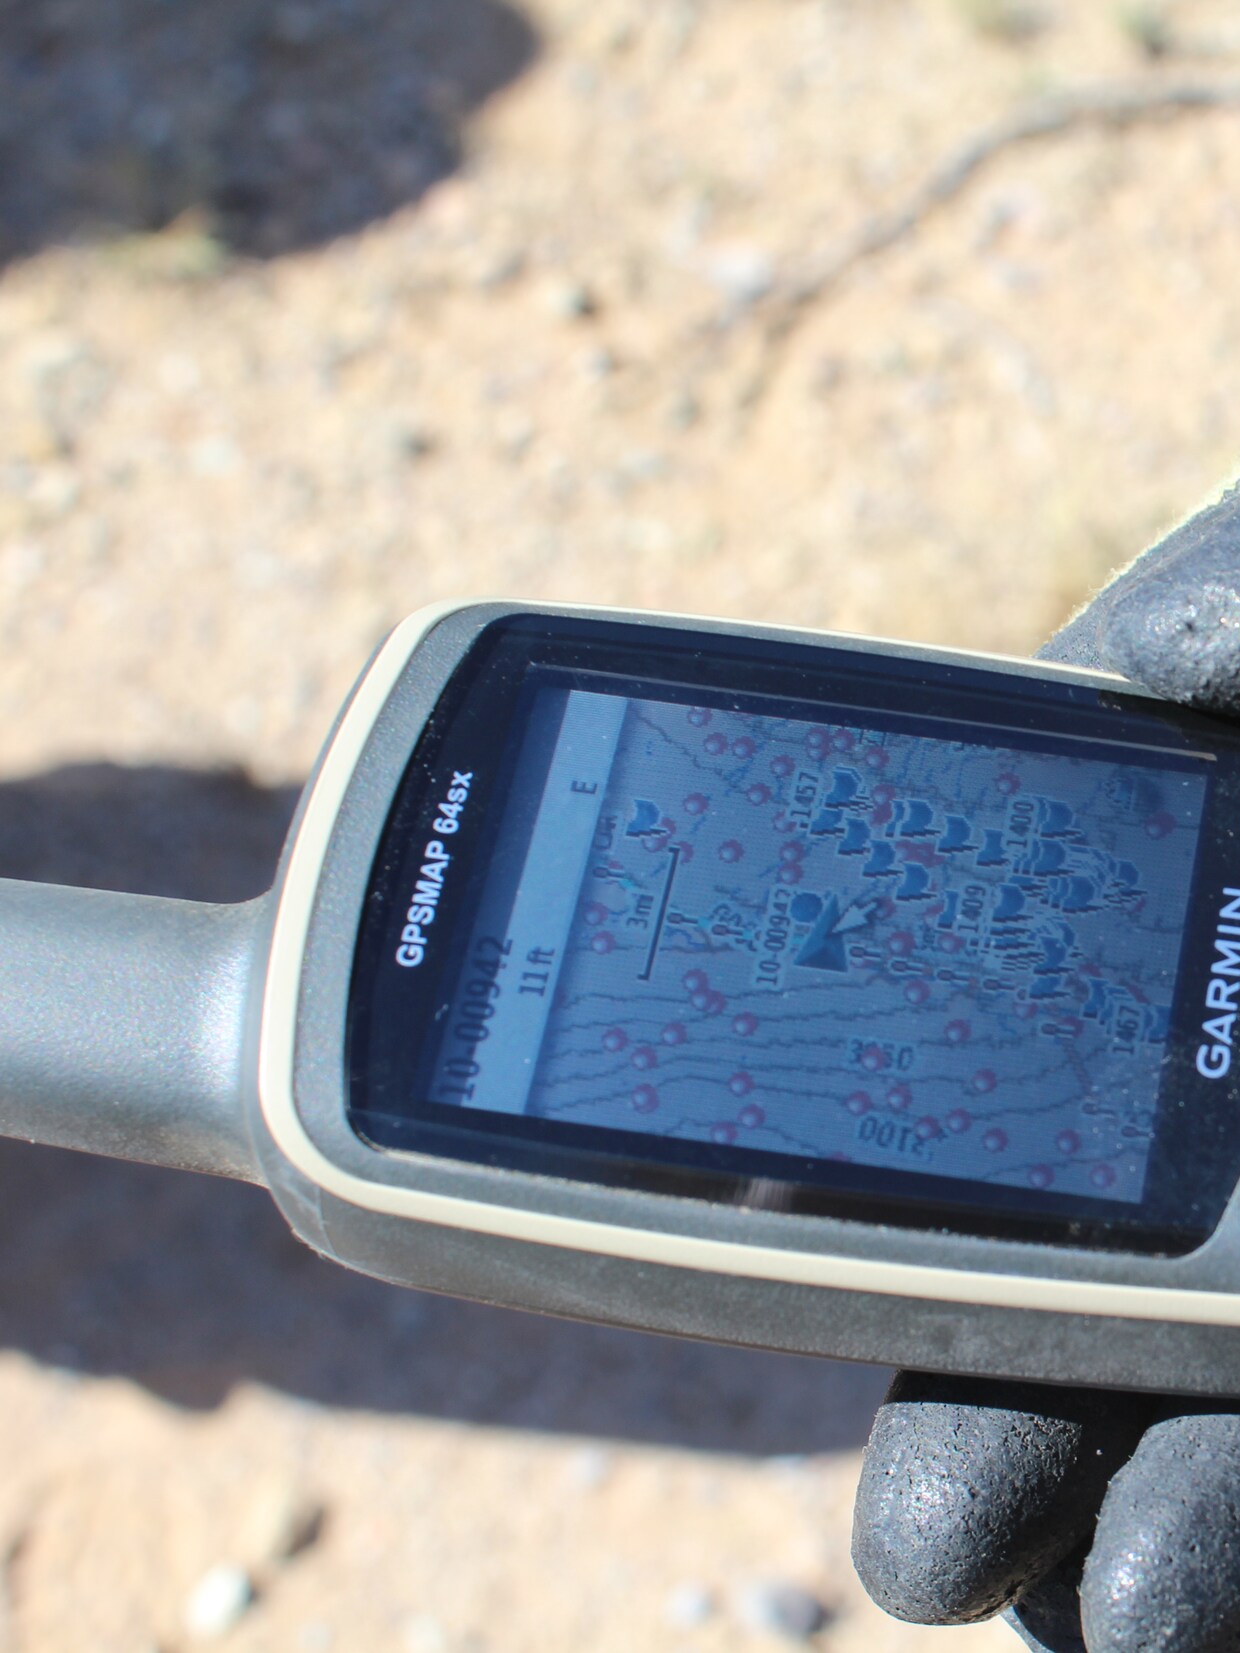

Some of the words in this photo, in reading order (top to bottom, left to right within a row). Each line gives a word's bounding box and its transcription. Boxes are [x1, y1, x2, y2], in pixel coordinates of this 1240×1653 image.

[396, 840, 450, 968] GPSMAP
[433, 770, 473, 835] 64sx
[571, 781, 597, 795] E
[439, 935, 513, 1100] 10-00942
